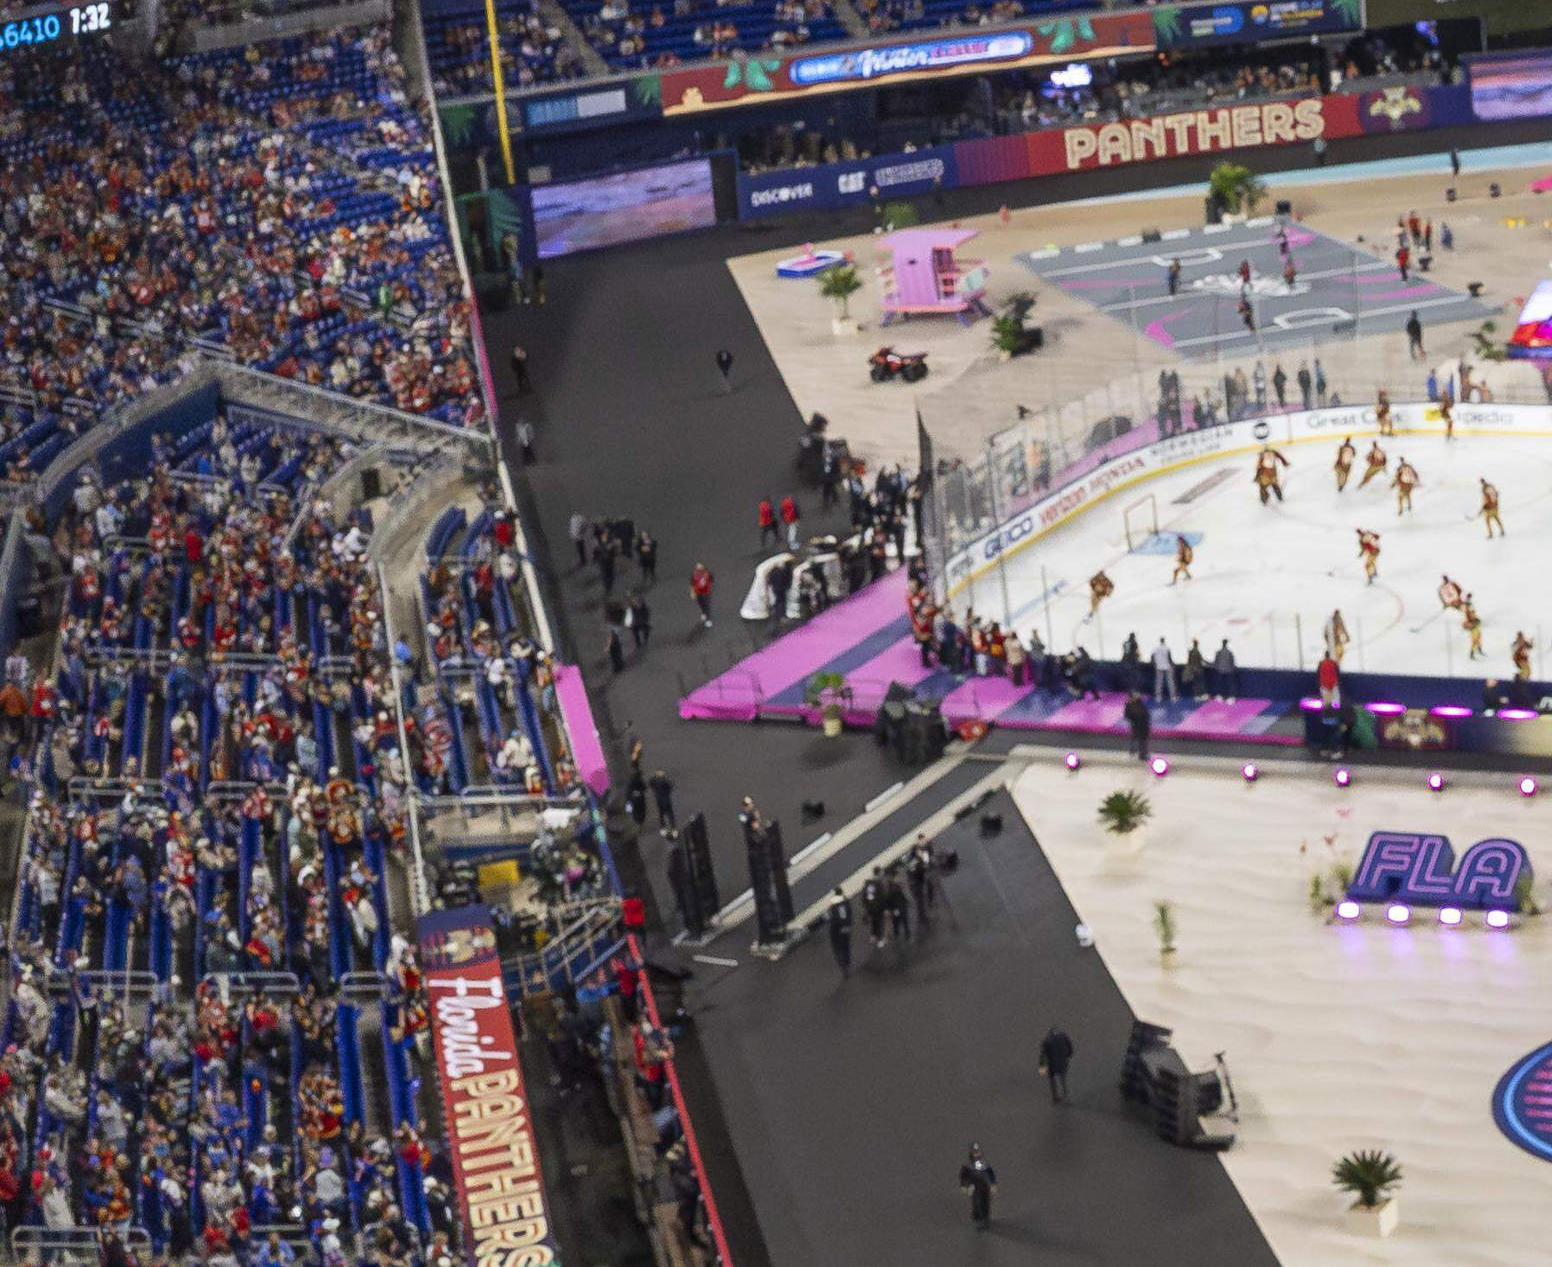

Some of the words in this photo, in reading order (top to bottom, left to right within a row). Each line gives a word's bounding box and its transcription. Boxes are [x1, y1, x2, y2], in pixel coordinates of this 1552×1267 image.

[0, 14, 61, 51] 6410
[68, 1, 112, 35] 1:32
[1063, 97, 1326, 170] PANTHERS
[1354, 832, 1526, 900] FLA
[427, 975, 513, 1080] Florida
